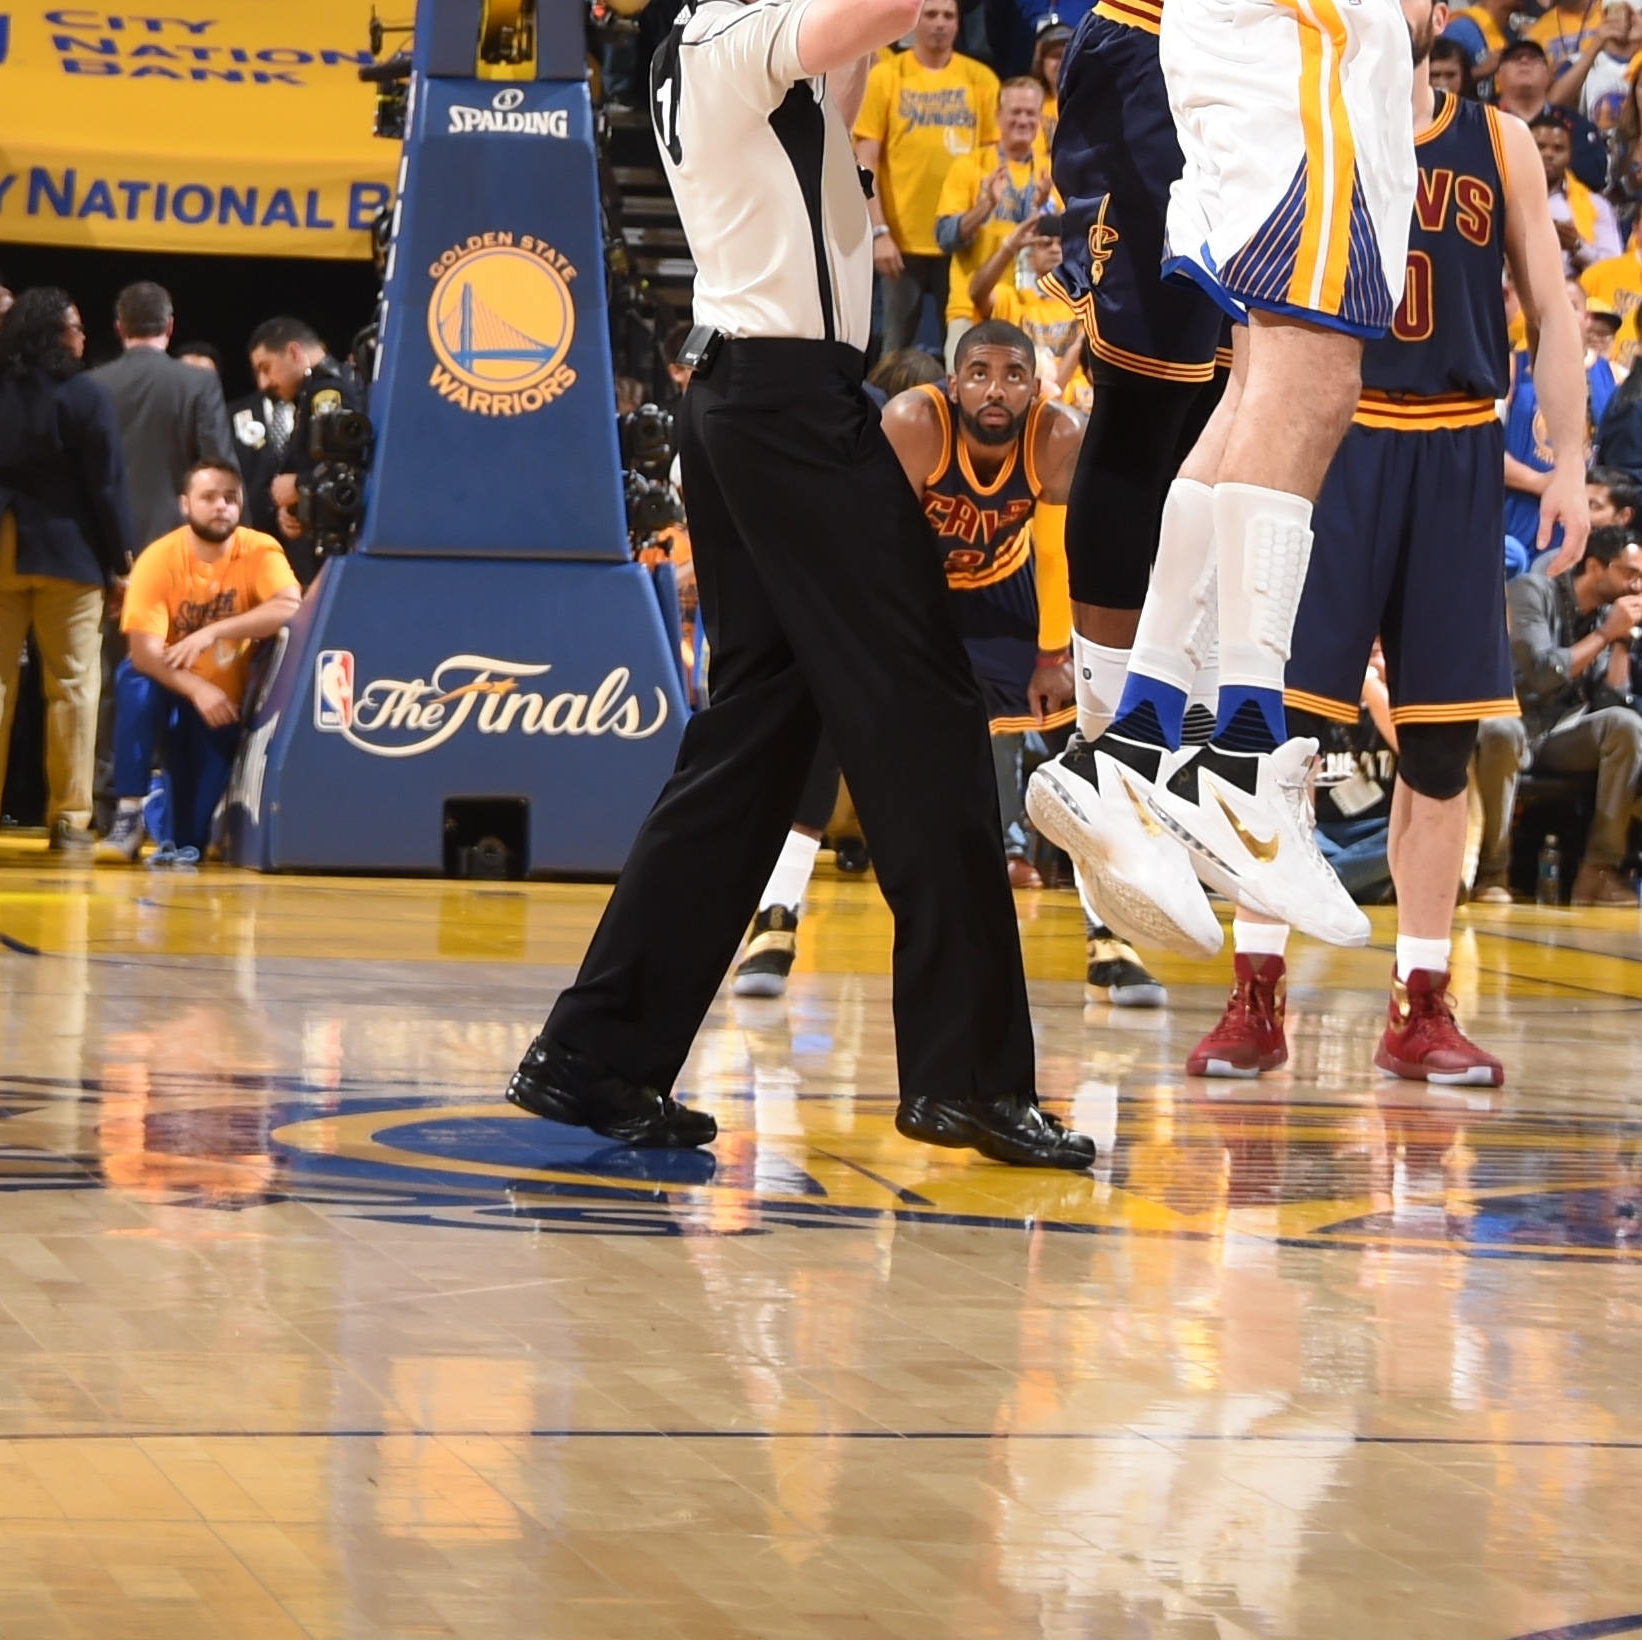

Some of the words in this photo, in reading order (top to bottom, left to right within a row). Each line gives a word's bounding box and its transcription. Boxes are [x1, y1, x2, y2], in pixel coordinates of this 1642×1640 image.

[44, 9, 218, 35] CITY
[52, 34, 377, 67] NATION
[62, 59, 308, 87] BANK
[448, 105, 570, 139] SPALDING
[656, 77, 681, 147] 1
[28, 167, 336, 231] NATIONAL
[428, 231, 514, 281] GOLDEN
[520, 234, 578, 282] STATE
[429, 362, 578, 418] WARRIORS
[353, 678, 445, 731] The
[431, 653, 669, 742] Finals
